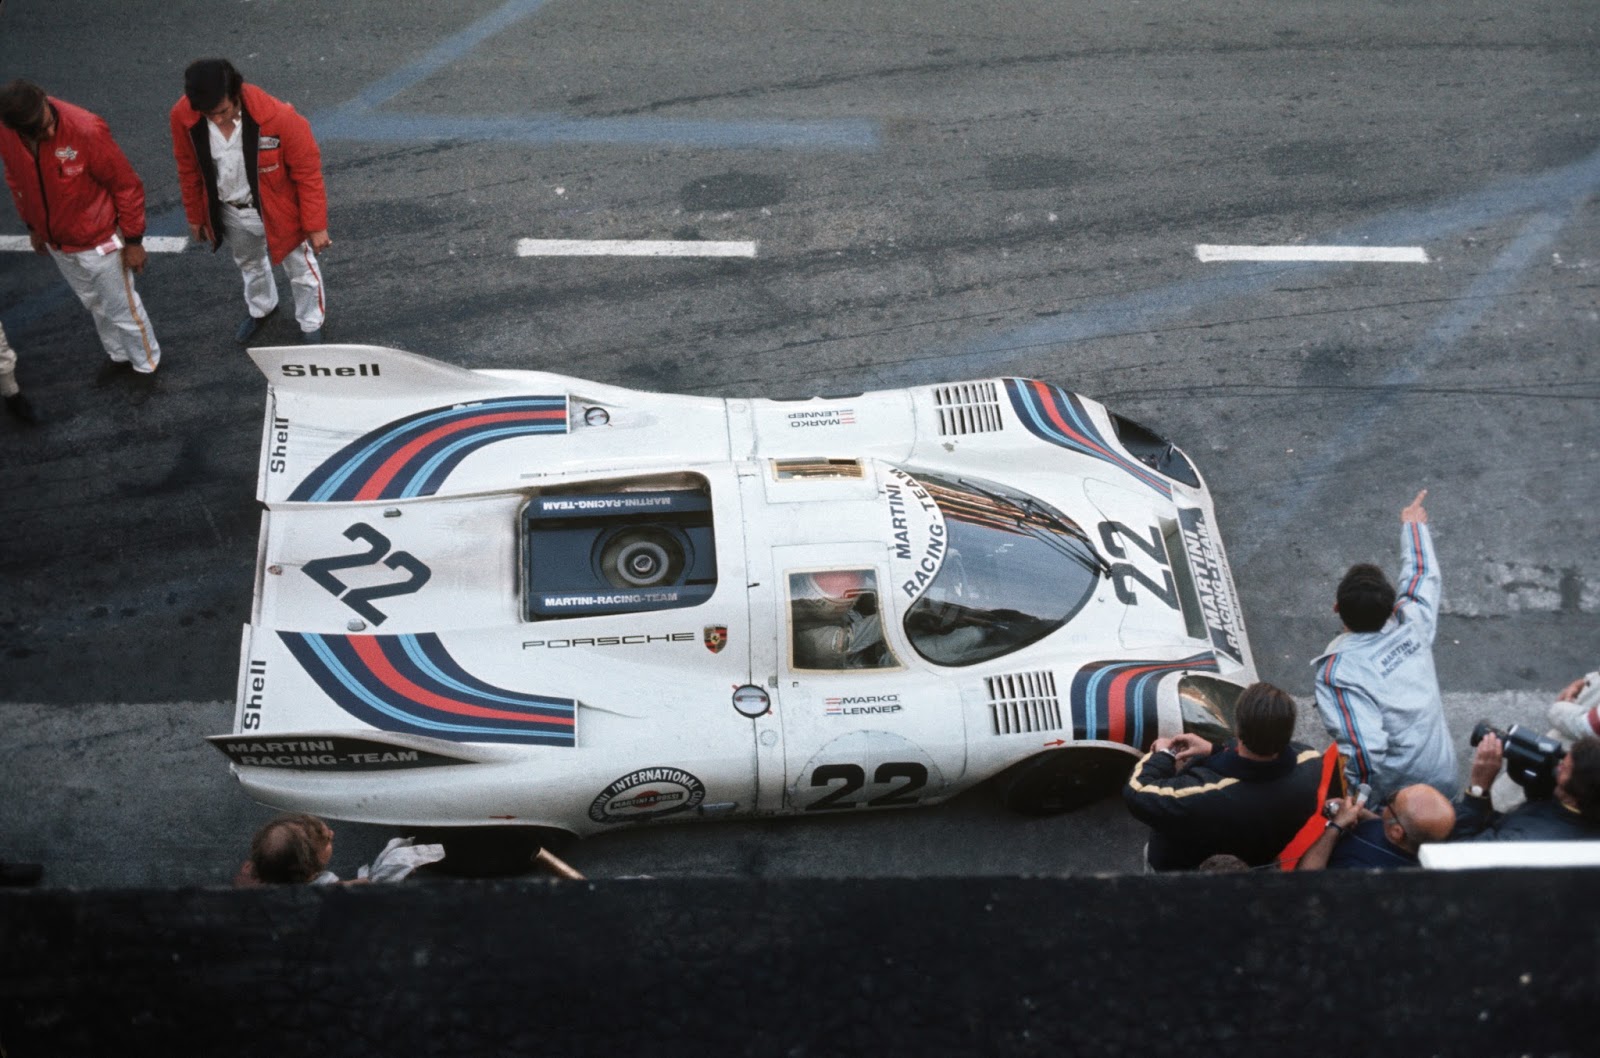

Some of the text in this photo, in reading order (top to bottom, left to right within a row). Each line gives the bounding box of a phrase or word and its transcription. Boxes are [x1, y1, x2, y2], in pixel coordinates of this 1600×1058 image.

[281, 363, 381, 377] Shell
[787, 410, 840, 419] LENNEP
[790, 418, 841, 428] MARKO
[270, 417, 290, 474] Shell
[543, 497, 671, 511] MARTINI-RACING-TEAM
[885, 483, 912, 560] MARTINI
[300, 521, 432, 627] 22
[1098, 520, 1181, 611] 22
[1183, 529, 1223, 631] MARTINI
[544, 592, 678, 607] MARTINI-RACING-TEAM
[522, 632, 696, 650] PORSCHE
[1380, 638, 1413, 666] MARTINI
[243, 660, 267, 731] Shell
[842, 694, 900, 705] MARKO
[842, 704, 902, 716] LENNEP
[226, 740, 335, 754] MARTINI
[240, 750, 419, 767] RACING-TEAM
[612, 768, 699, 793] INTERNATIONAL
[805, 761, 929, 811] 22
